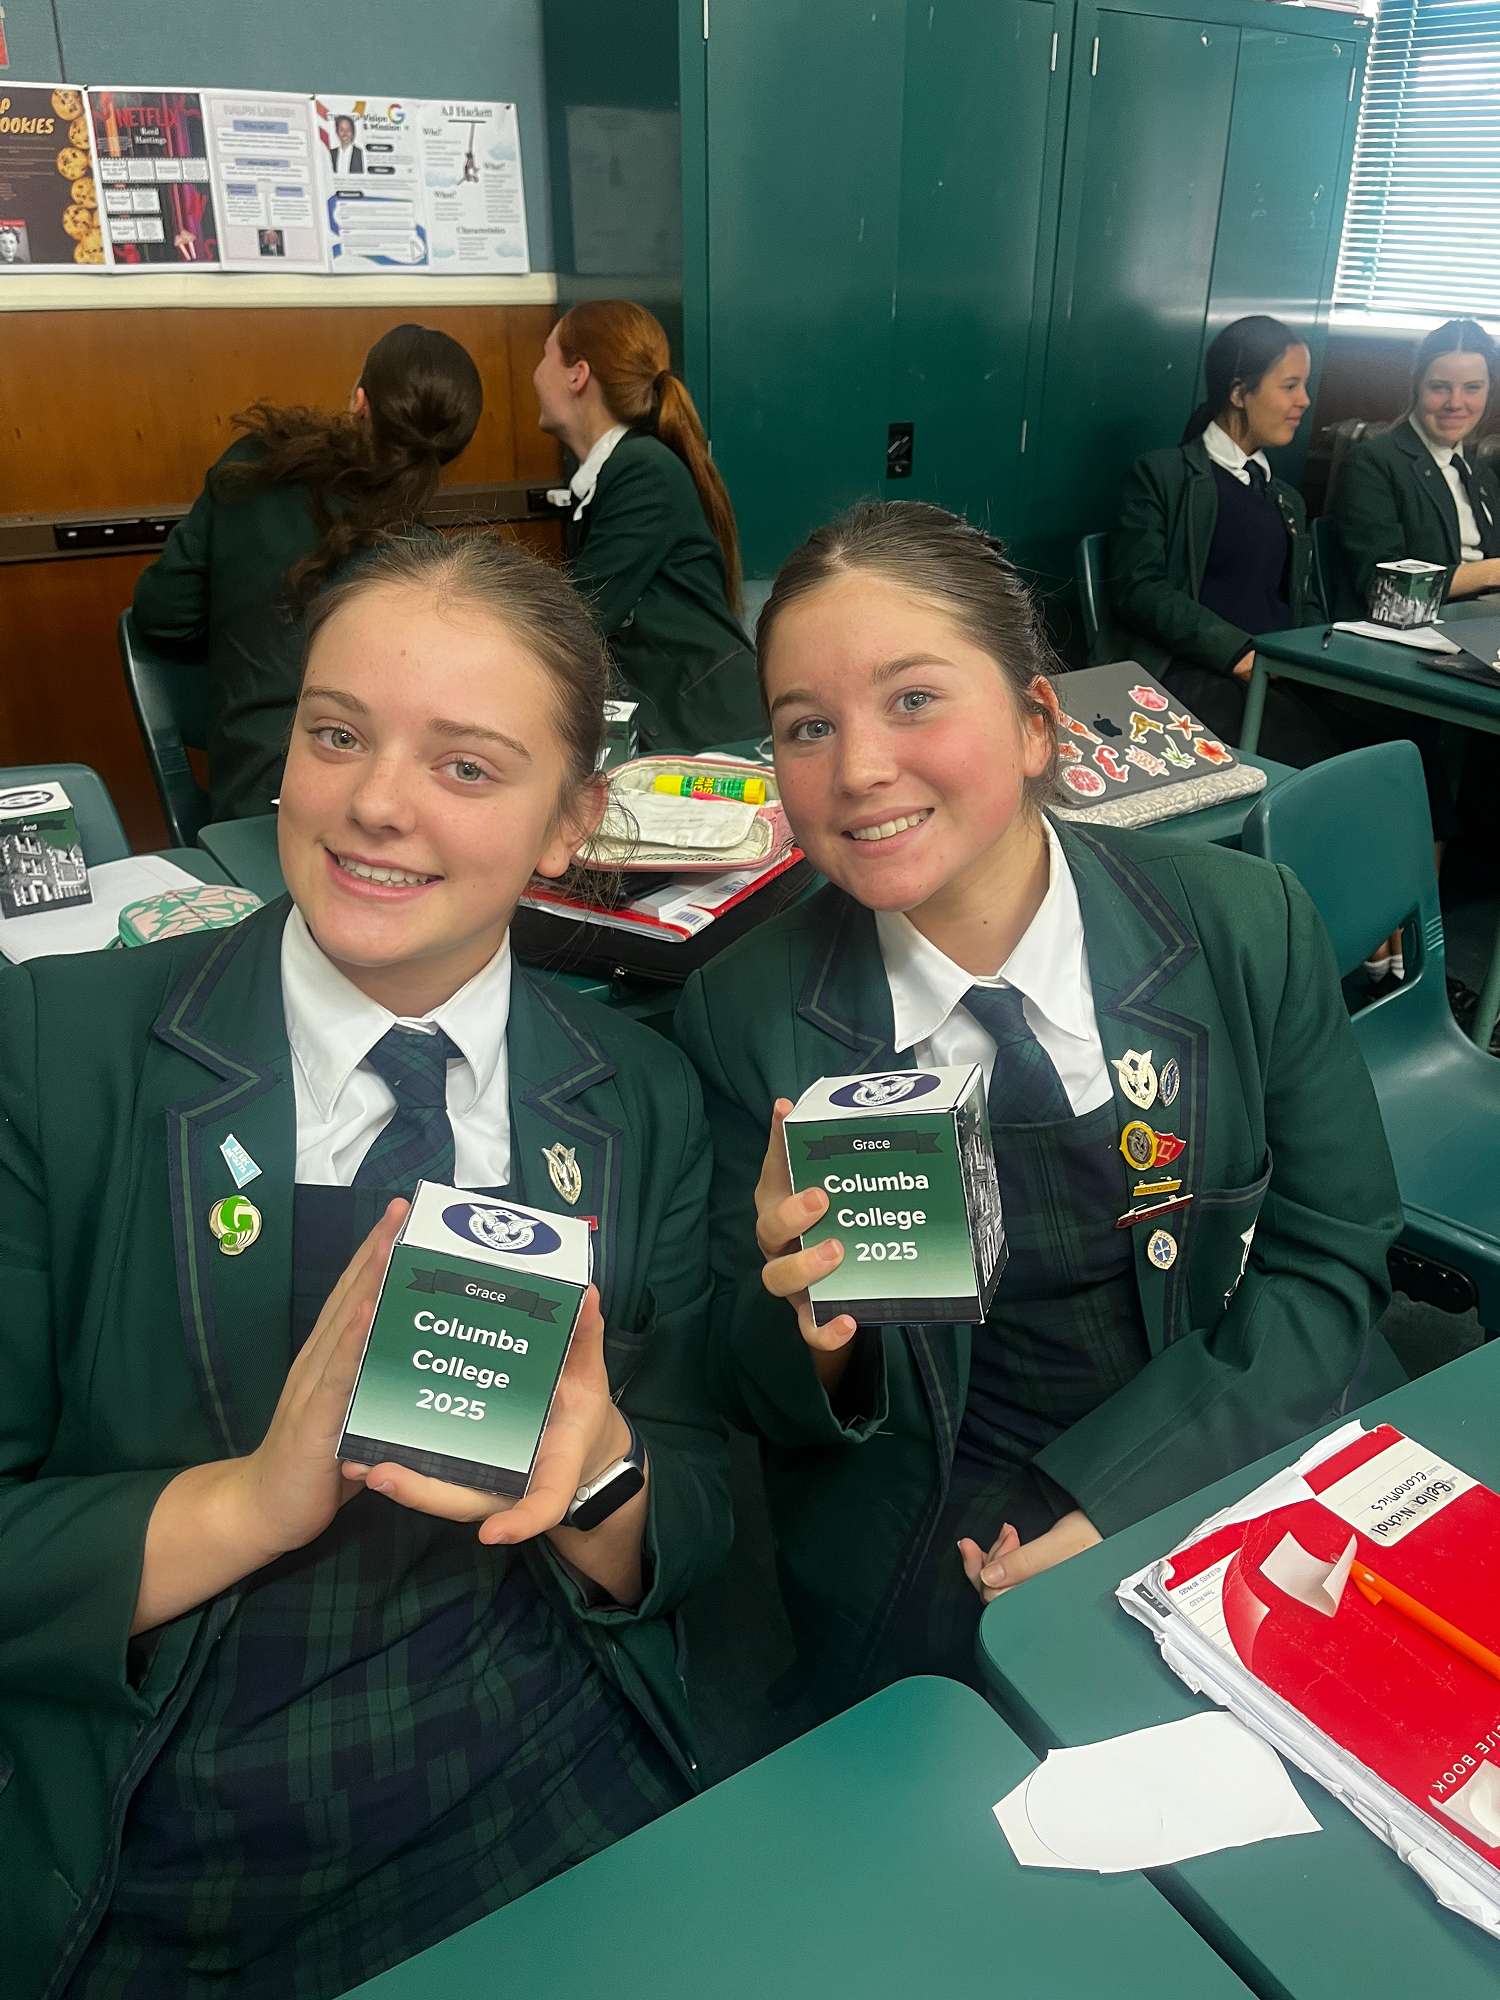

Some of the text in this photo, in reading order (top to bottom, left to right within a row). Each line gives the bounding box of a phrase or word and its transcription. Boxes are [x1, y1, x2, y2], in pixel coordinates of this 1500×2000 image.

[116, 107, 179, 128] NETFLIX
[852, 1138, 891, 1151] Grace
[823, 1171, 930, 1194] Columba
[837, 1208, 927, 1230] College
[855, 1241, 918, 1262] 2025
[464, 1283, 507, 1303] Grace
[413, 1310, 530, 1355] Columba
[412, 1350, 511, 1389] College
[415, 1389, 487, 1421] 2025
[1371, 1481, 1452, 1537] Bella Nichol
[1431, 1754, 1477, 1794] BOOK
